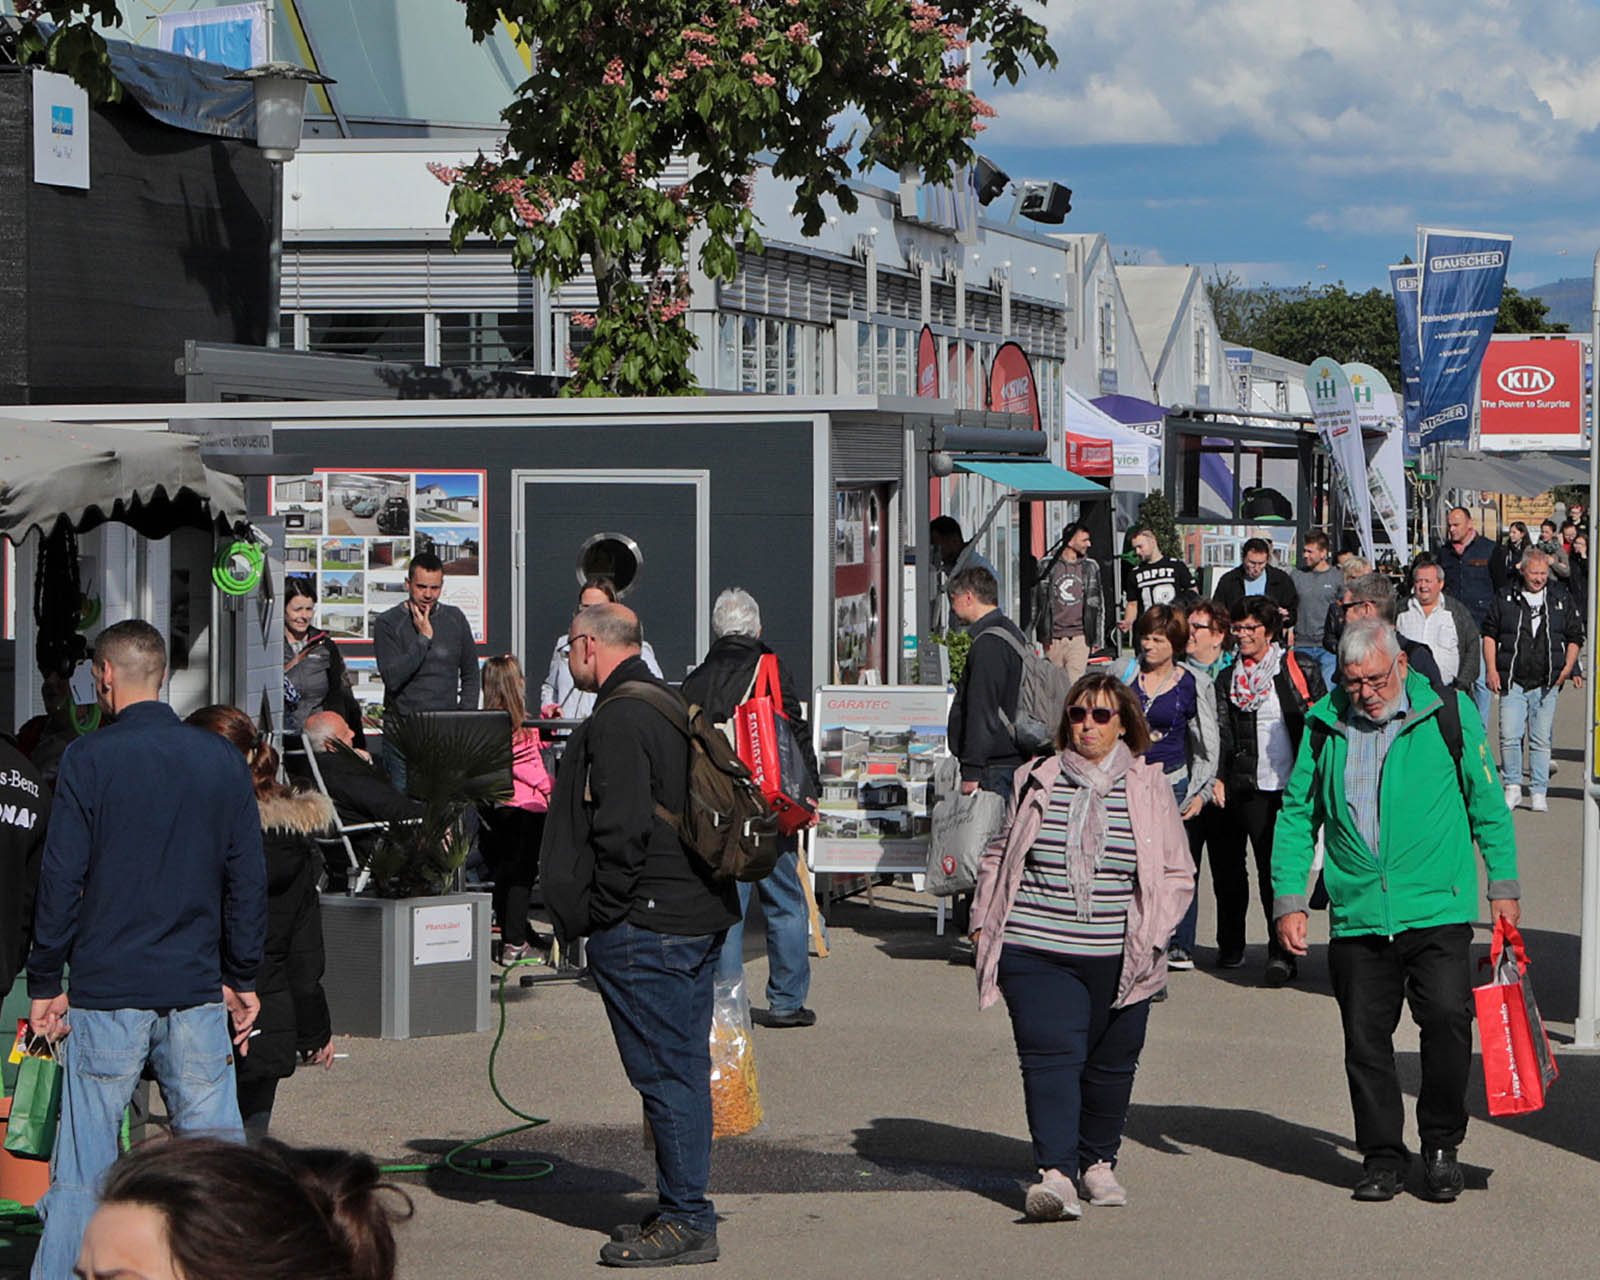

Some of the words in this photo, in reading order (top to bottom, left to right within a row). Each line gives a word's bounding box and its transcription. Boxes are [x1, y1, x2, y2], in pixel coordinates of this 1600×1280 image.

[1434, 254, 1500, 270] BAUSCHER
[1507, 372, 1545, 389] KIA
[1481, 400, 1497, 408] The
[1498, 400, 1525, 408] Power
[1526, 400, 1536, 408] to
[1537, 400, 1571, 409] Surprise
[827, 699, 891, 711] GARATEC
